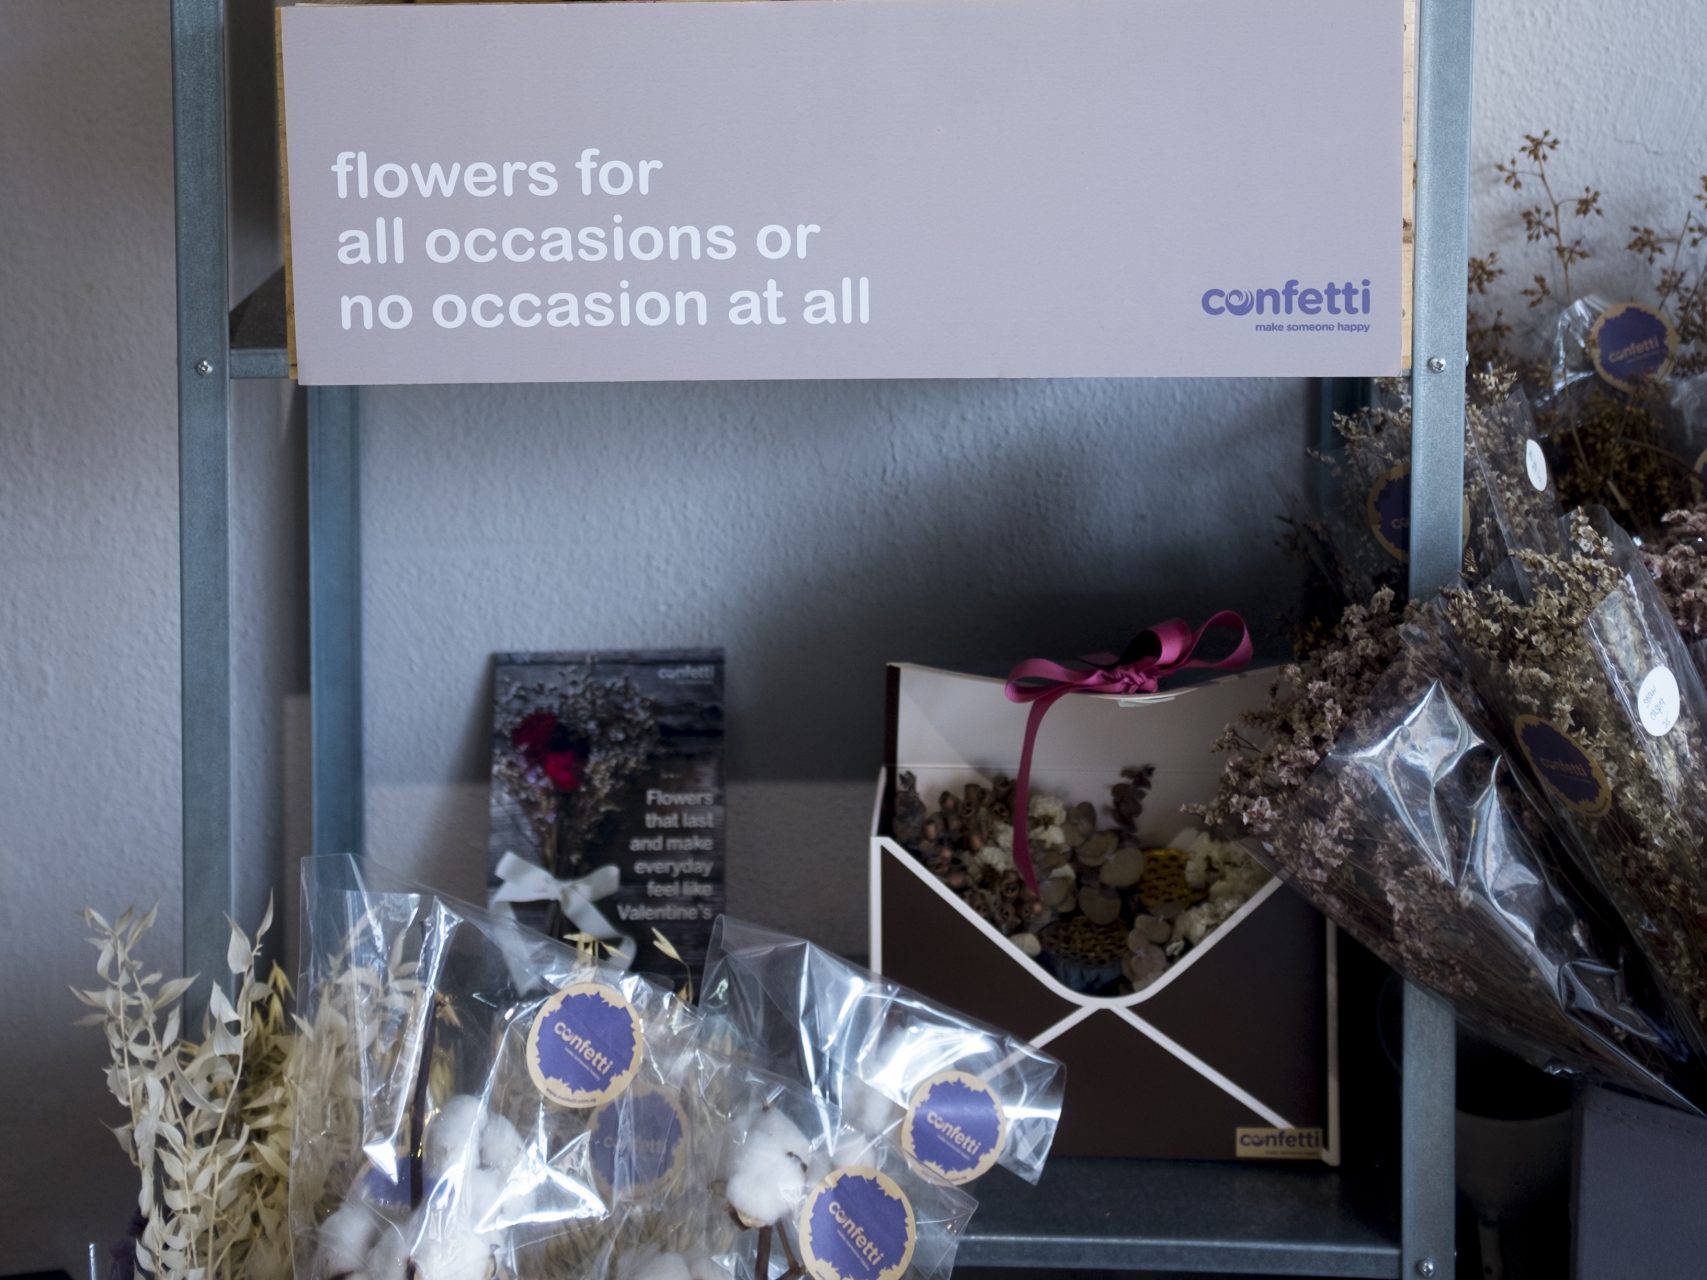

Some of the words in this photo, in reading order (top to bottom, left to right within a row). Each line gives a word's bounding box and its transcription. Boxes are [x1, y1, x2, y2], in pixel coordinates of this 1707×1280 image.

[331, 151, 558, 198] flowers
[575, 148, 662, 195] for
[337, 217, 404, 264] all
[425, 214, 737, 263] occasions
[756, 223, 821, 259] or
[341, 293, 413, 330] no
[432, 279, 707, 328] occasion
[728, 279, 786, 324] at
[803, 276, 869, 323] all
[1202, 279, 1370, 316] confetti
[1256, 323, 1284, 332] make
[1287, 323, 1335, 332] someone
[1337, 322, 1370, 333] happy
[646, 790, 714, 806] Flowers
[645, 813, 679, 829] that
[682, 812, 714, 828] last
[629, 836, 663, 851] and
[666, 836, 714, 851] make
[634, 859, 713, 877] everyday
[617, 904, 713, 921] Valentine's
[554, 1022, 614, 1075] confetti
[927, 1110, 982, 1155] confetti
[1240, 1130, 1320, 1148] confetti
[828, 1201, 884, 1266] confetti
